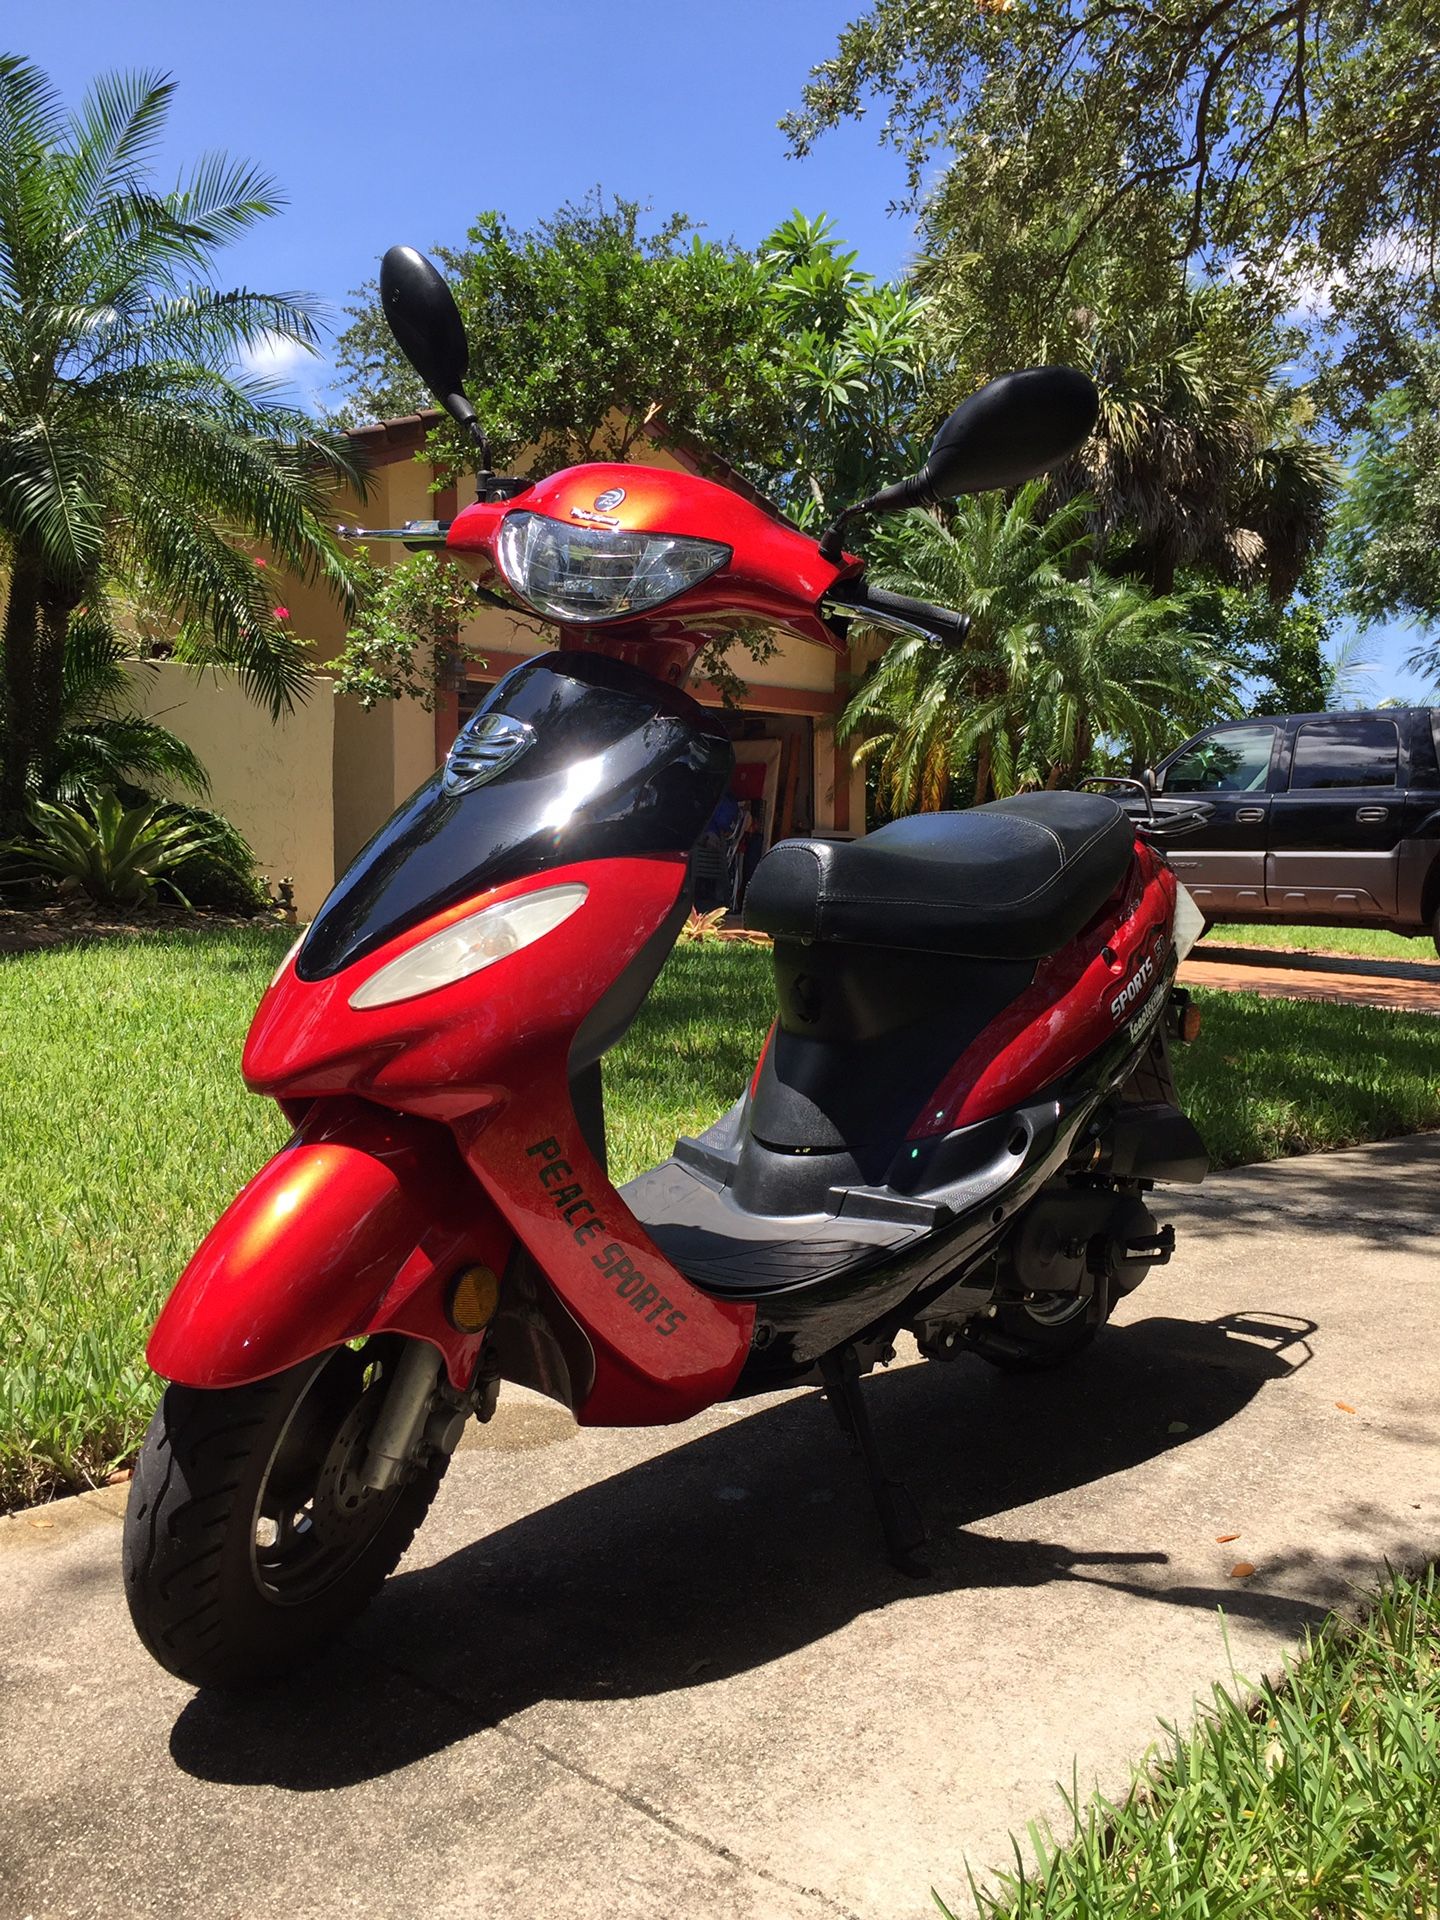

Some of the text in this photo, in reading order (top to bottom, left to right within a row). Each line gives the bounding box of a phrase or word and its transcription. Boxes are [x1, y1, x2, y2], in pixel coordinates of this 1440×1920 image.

[1111, 956, 1153, 1020] SPORTS
[526, 1135, 688, 1337] PEACE SPORTS
